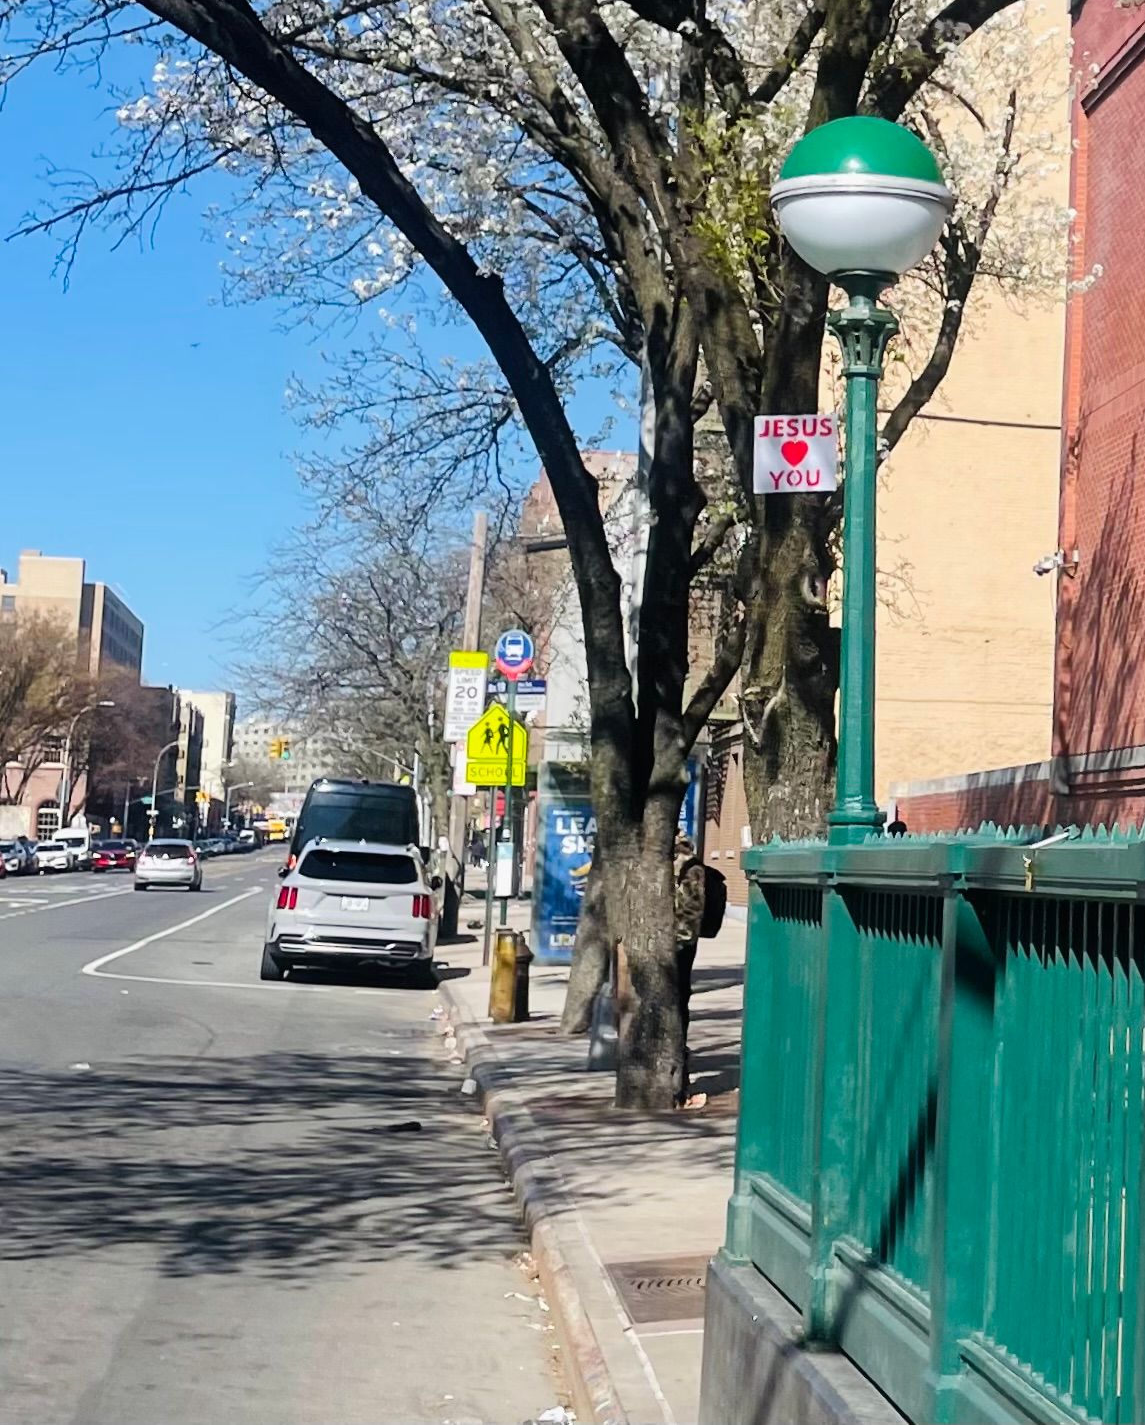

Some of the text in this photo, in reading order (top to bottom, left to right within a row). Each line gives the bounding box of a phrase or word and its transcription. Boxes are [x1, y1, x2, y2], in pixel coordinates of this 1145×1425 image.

[759, 418, 833, 438] JESUS
[769, 469, 821, 491] YOU
[455, 686, 478, 699] 20
[469, 767, 519, 778] SCHOL
